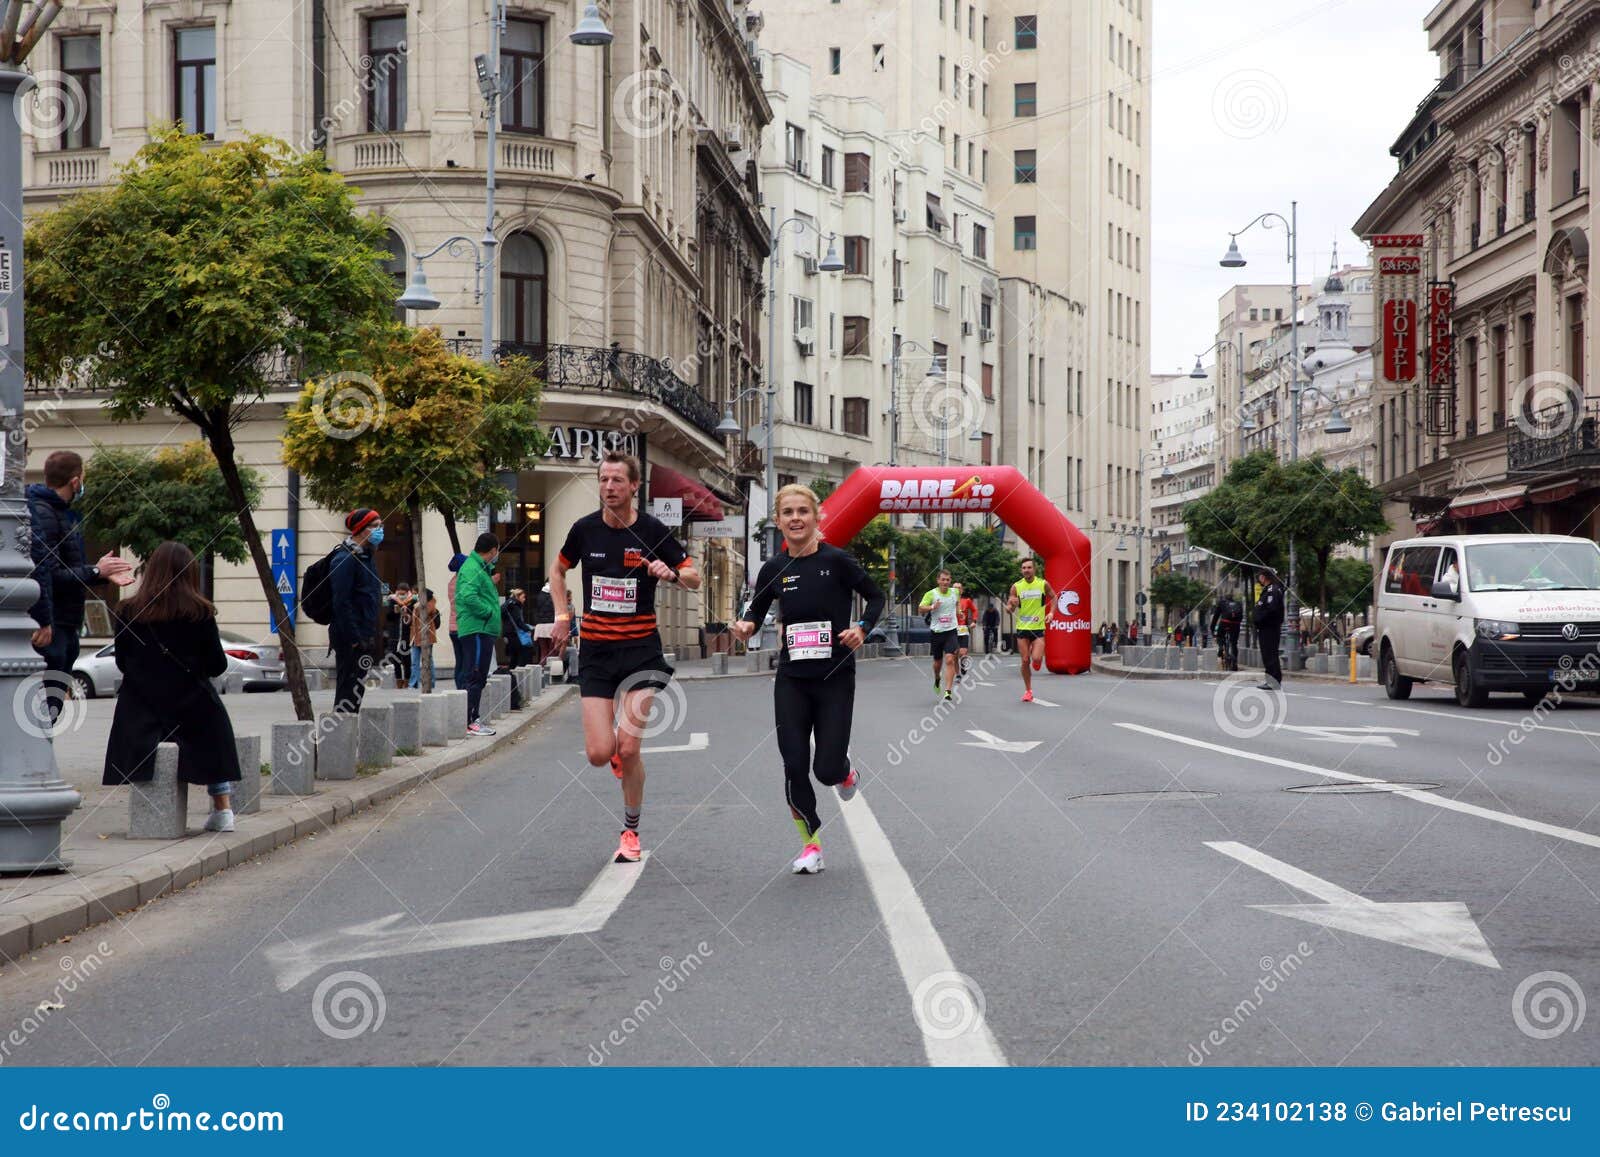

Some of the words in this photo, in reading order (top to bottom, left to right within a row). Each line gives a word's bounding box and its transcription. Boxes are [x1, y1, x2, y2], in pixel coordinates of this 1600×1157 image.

[1392, 299, 1408, 382] HOTEL
[543, 426, 638, 459] APITOL
[880, 479, 956, 498] DARE
[880, 498, 993, 510] CHALLENGE
[1050, 618, 1090, 632] Playtika
